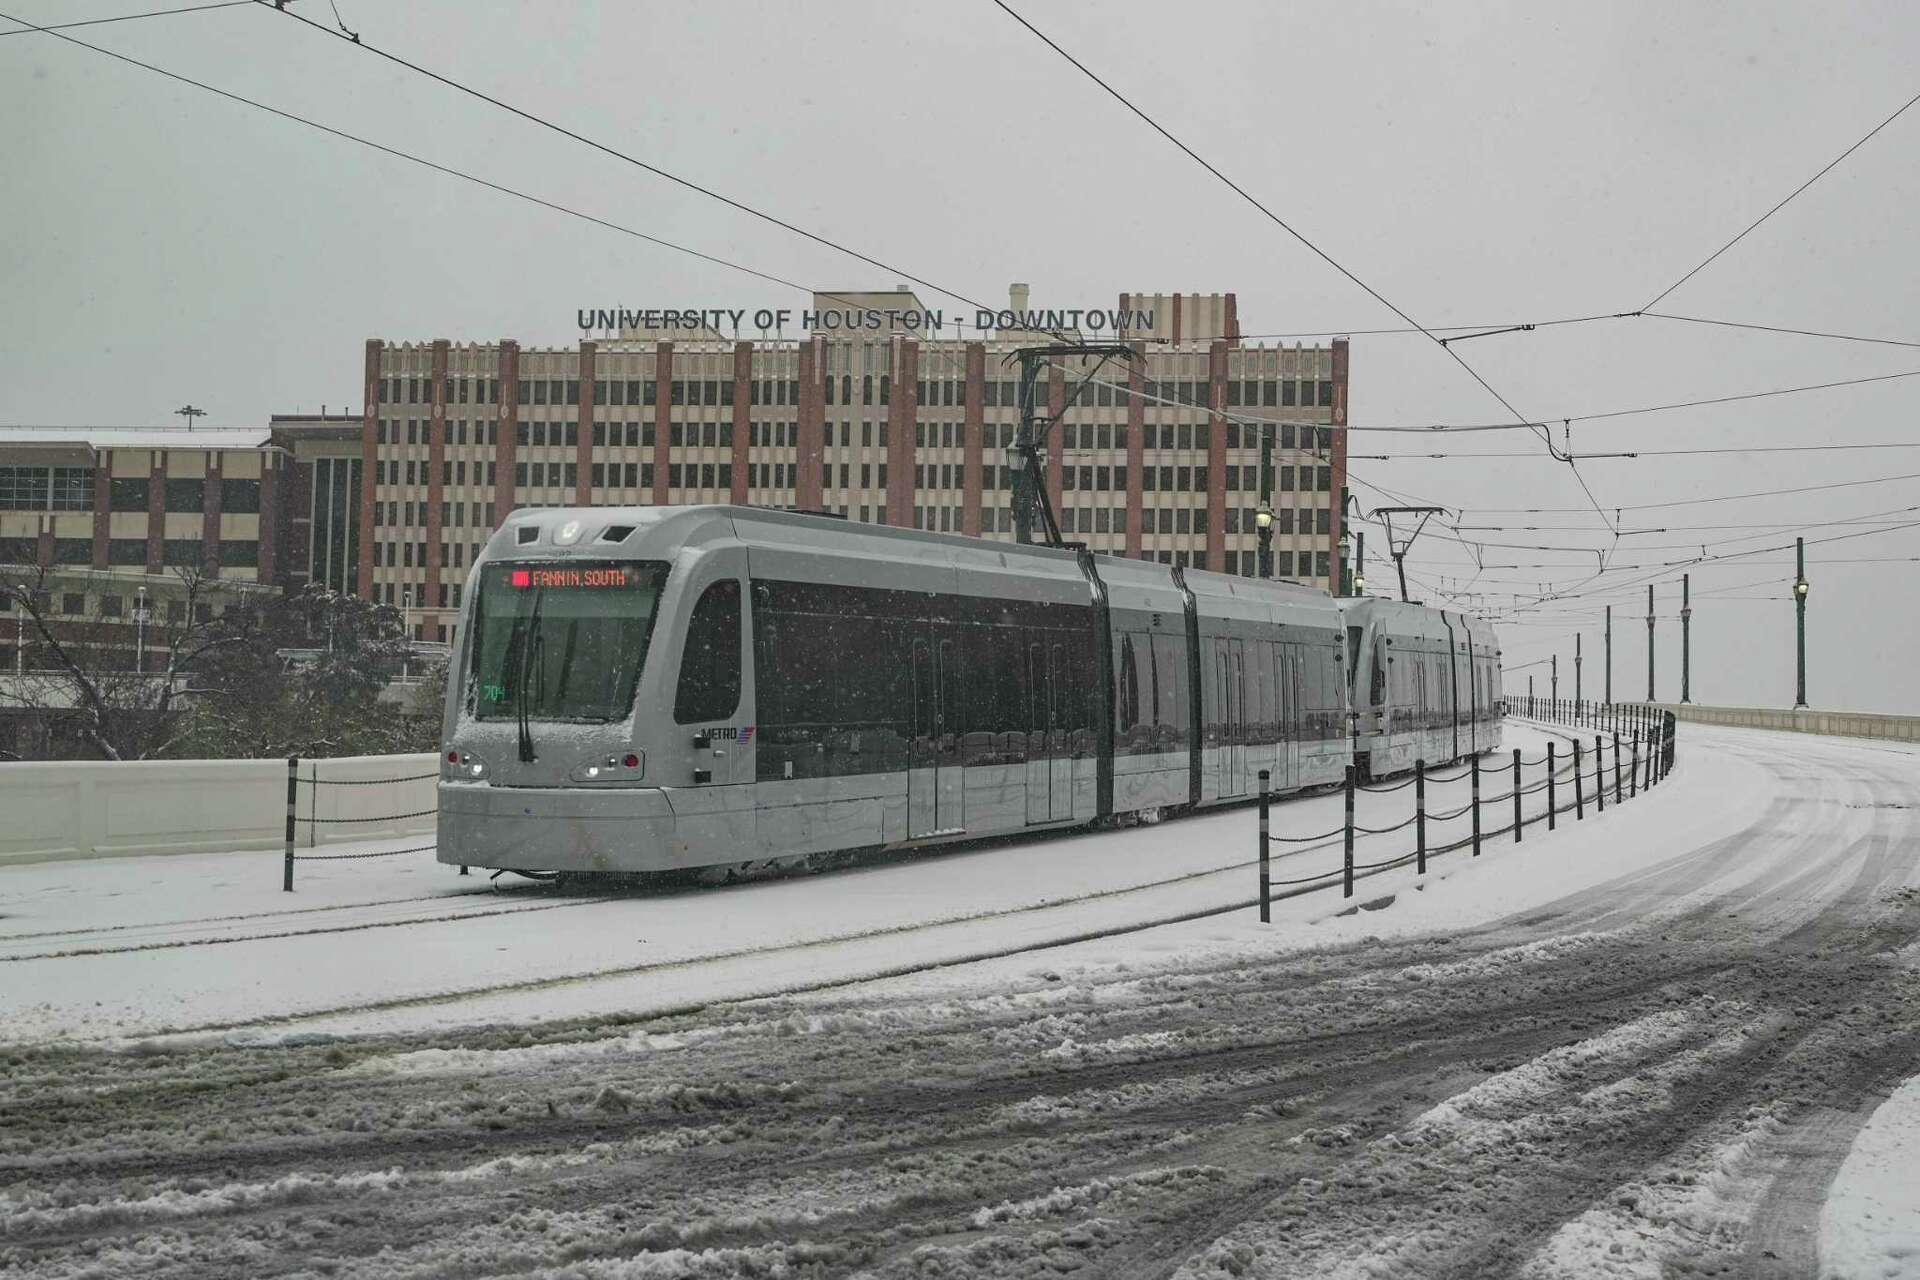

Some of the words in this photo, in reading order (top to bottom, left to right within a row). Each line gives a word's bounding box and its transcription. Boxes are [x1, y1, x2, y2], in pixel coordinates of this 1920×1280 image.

[577, 309, 745, 330] UNIVERSITY
[754, 309, 791, 330] OF
[803, 309, 942, 330] HOUSTON
[976, 309, 1154, 331] DOWNTOWN
[533, 570, 579, 586] FANNIN
[584, 570, 625, 586] SOUTH
[701, 727, 737, 740] METRO
